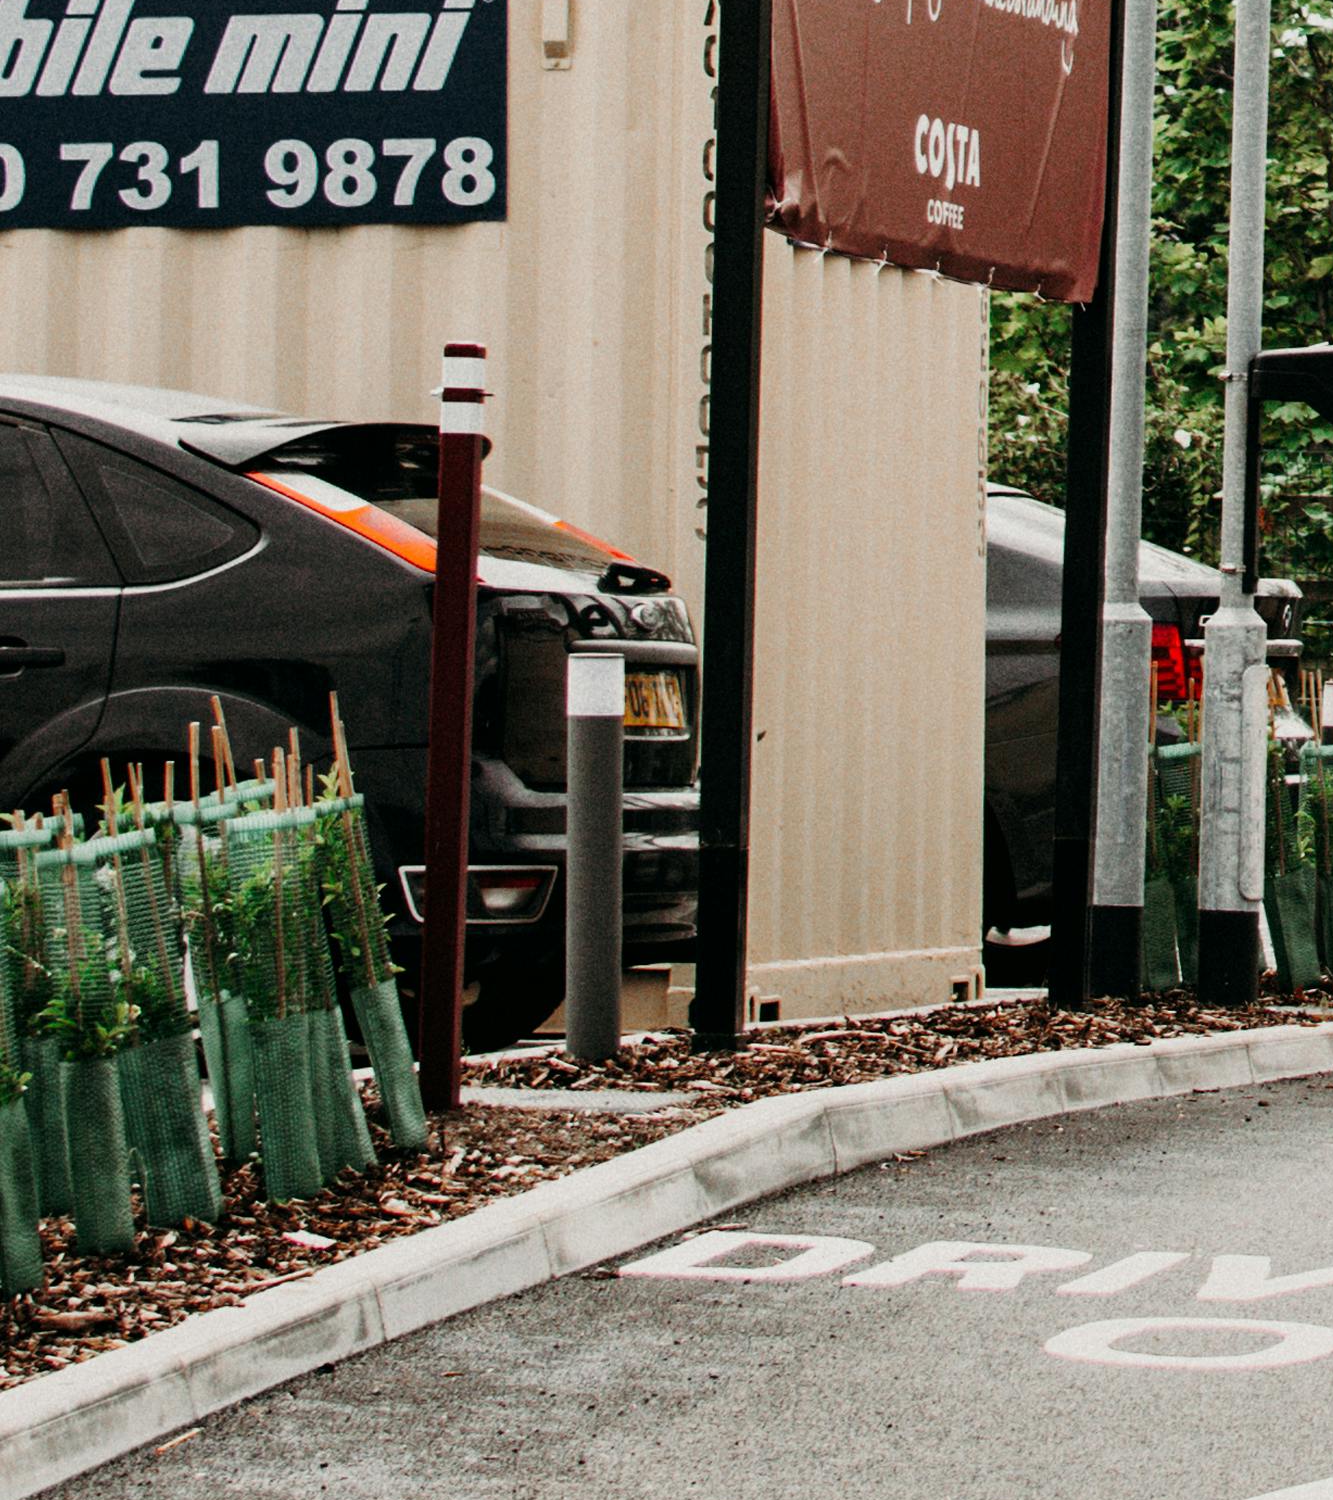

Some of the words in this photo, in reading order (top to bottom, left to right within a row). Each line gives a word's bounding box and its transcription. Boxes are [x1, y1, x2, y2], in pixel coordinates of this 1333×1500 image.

[59, 141, 219, 211] 731
[264, 136, 496, 207] 9878
[914, 113, 981, 191] COSTA
[926, 198, 965, 230] COFFEE
